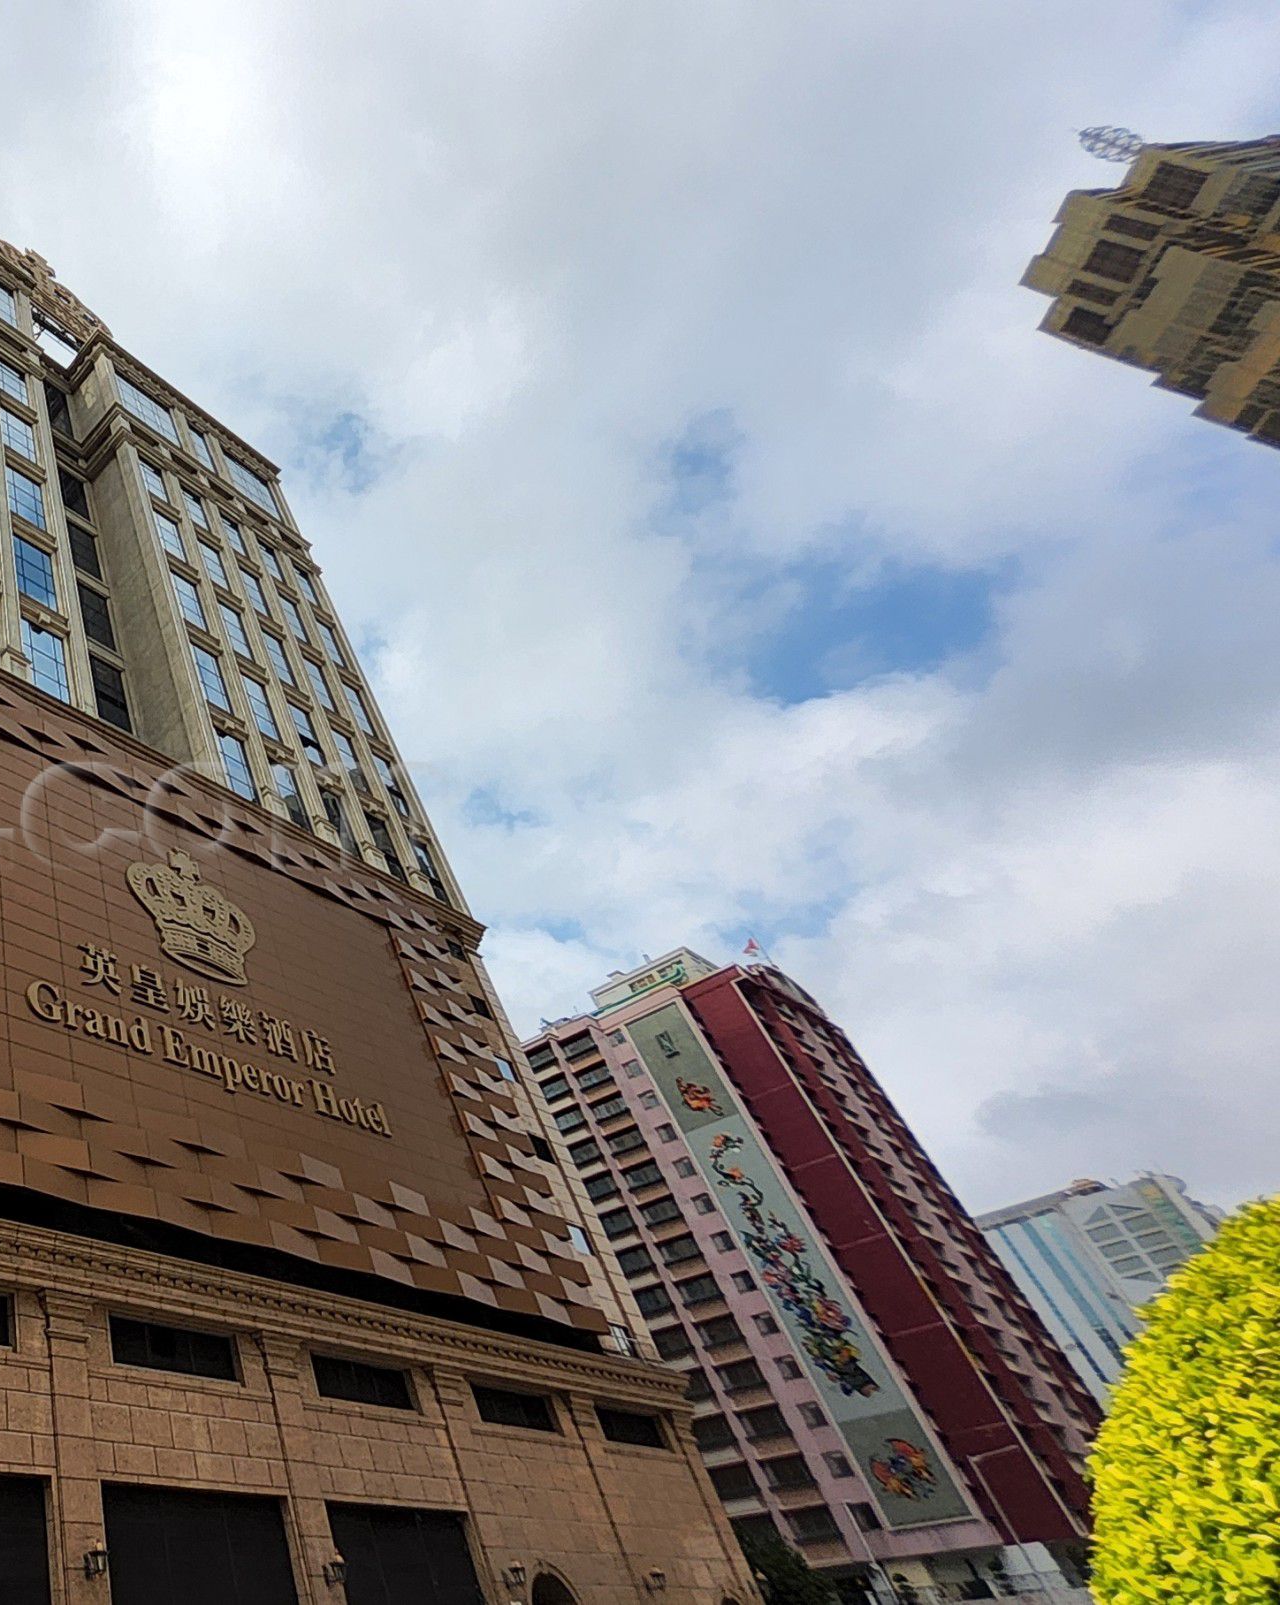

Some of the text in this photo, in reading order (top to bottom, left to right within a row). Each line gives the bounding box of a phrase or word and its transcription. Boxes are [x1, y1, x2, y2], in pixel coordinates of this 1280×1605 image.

[26, 980, 393, 1138] Grand Emperor Hotel
[77, 942, 336, 1075] 英皇娛樂酒店
